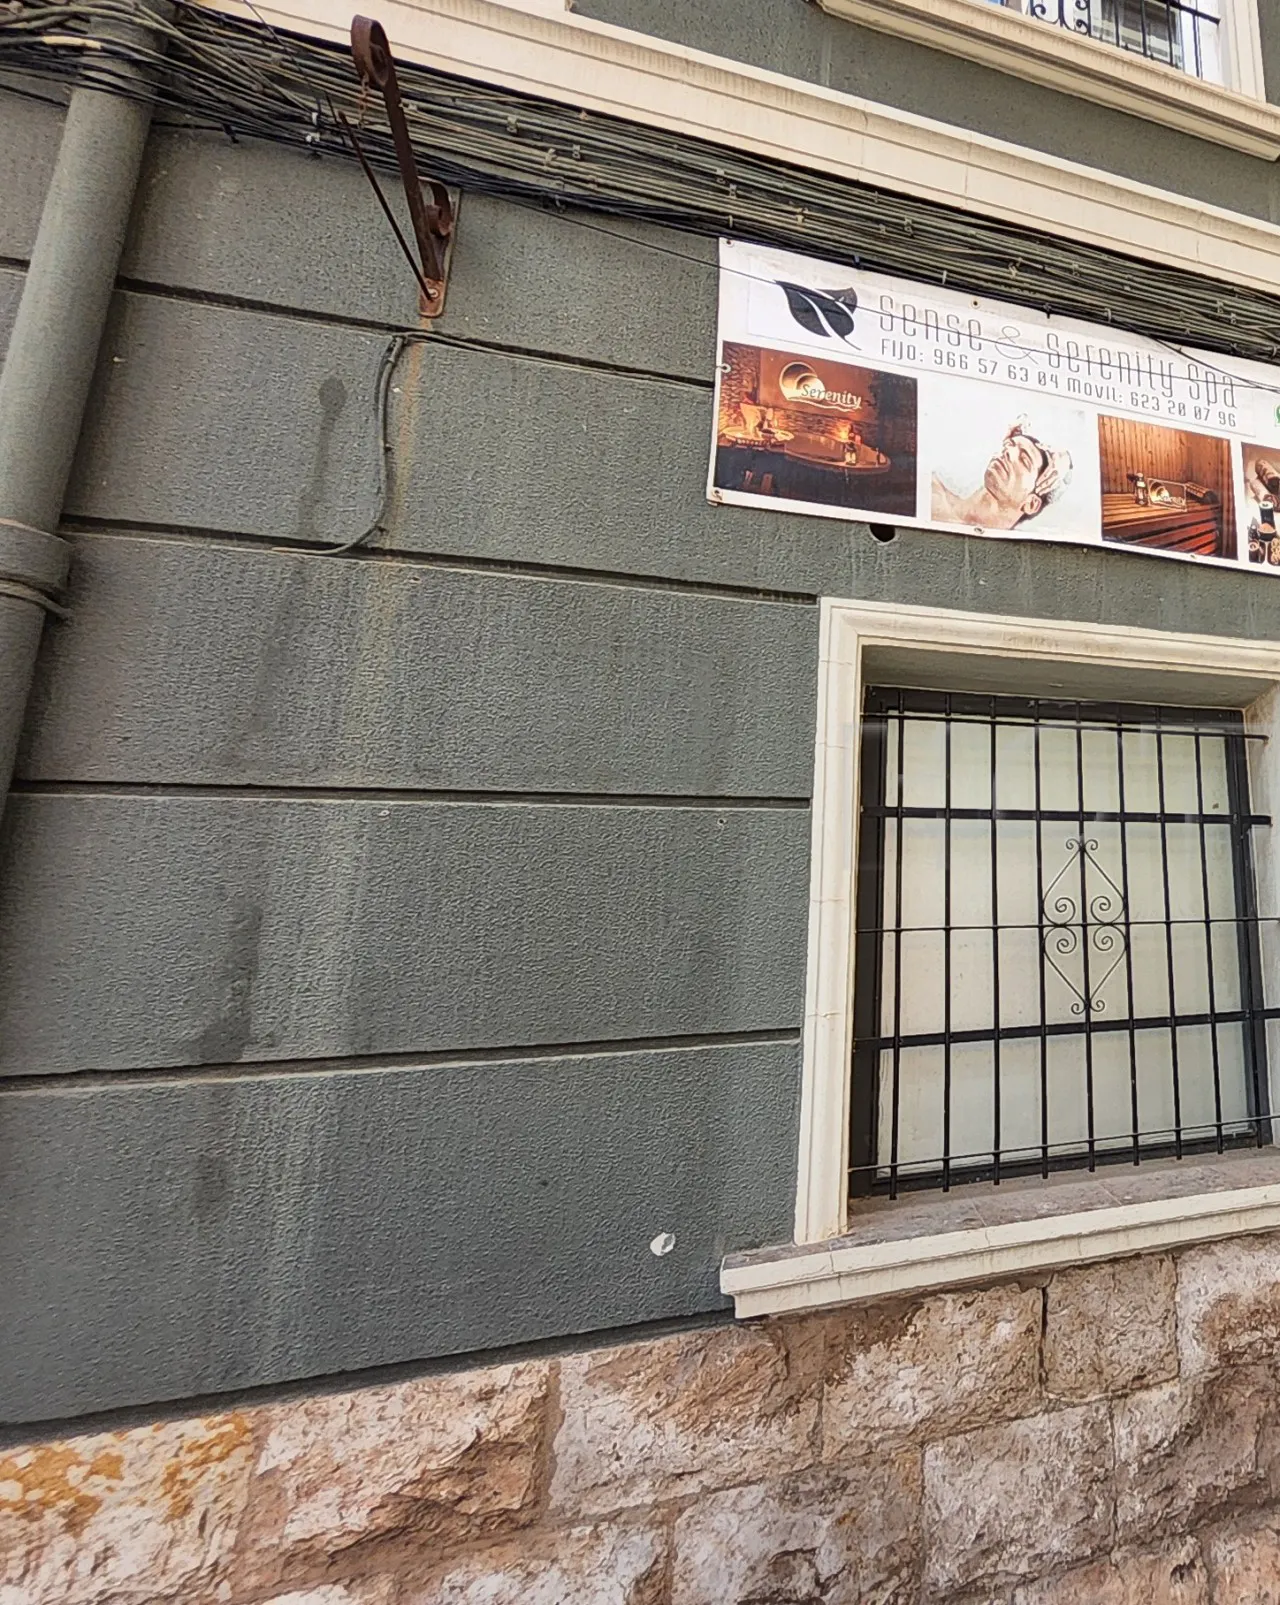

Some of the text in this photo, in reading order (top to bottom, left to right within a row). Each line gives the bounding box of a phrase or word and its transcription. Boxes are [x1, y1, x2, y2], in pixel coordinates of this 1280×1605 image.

[800, 383, 862, 410] Serenity
[879, 294, 1238, 410] Sense & Serenity Spa
[881, 338, 924, 362] FIJO:
[934, 348, 969, 370] 966
[978, 357, 998, 376] 57
[1007, 364, 1029, 383] 63
[1038, 370, 1059, 389] 04
[1130, 390, 1160, 412] 623
[1168, 400, 1187, 416] 20
[1194, 405, 1211, 421] 07
[1218, 411, 1237, 428] 96
